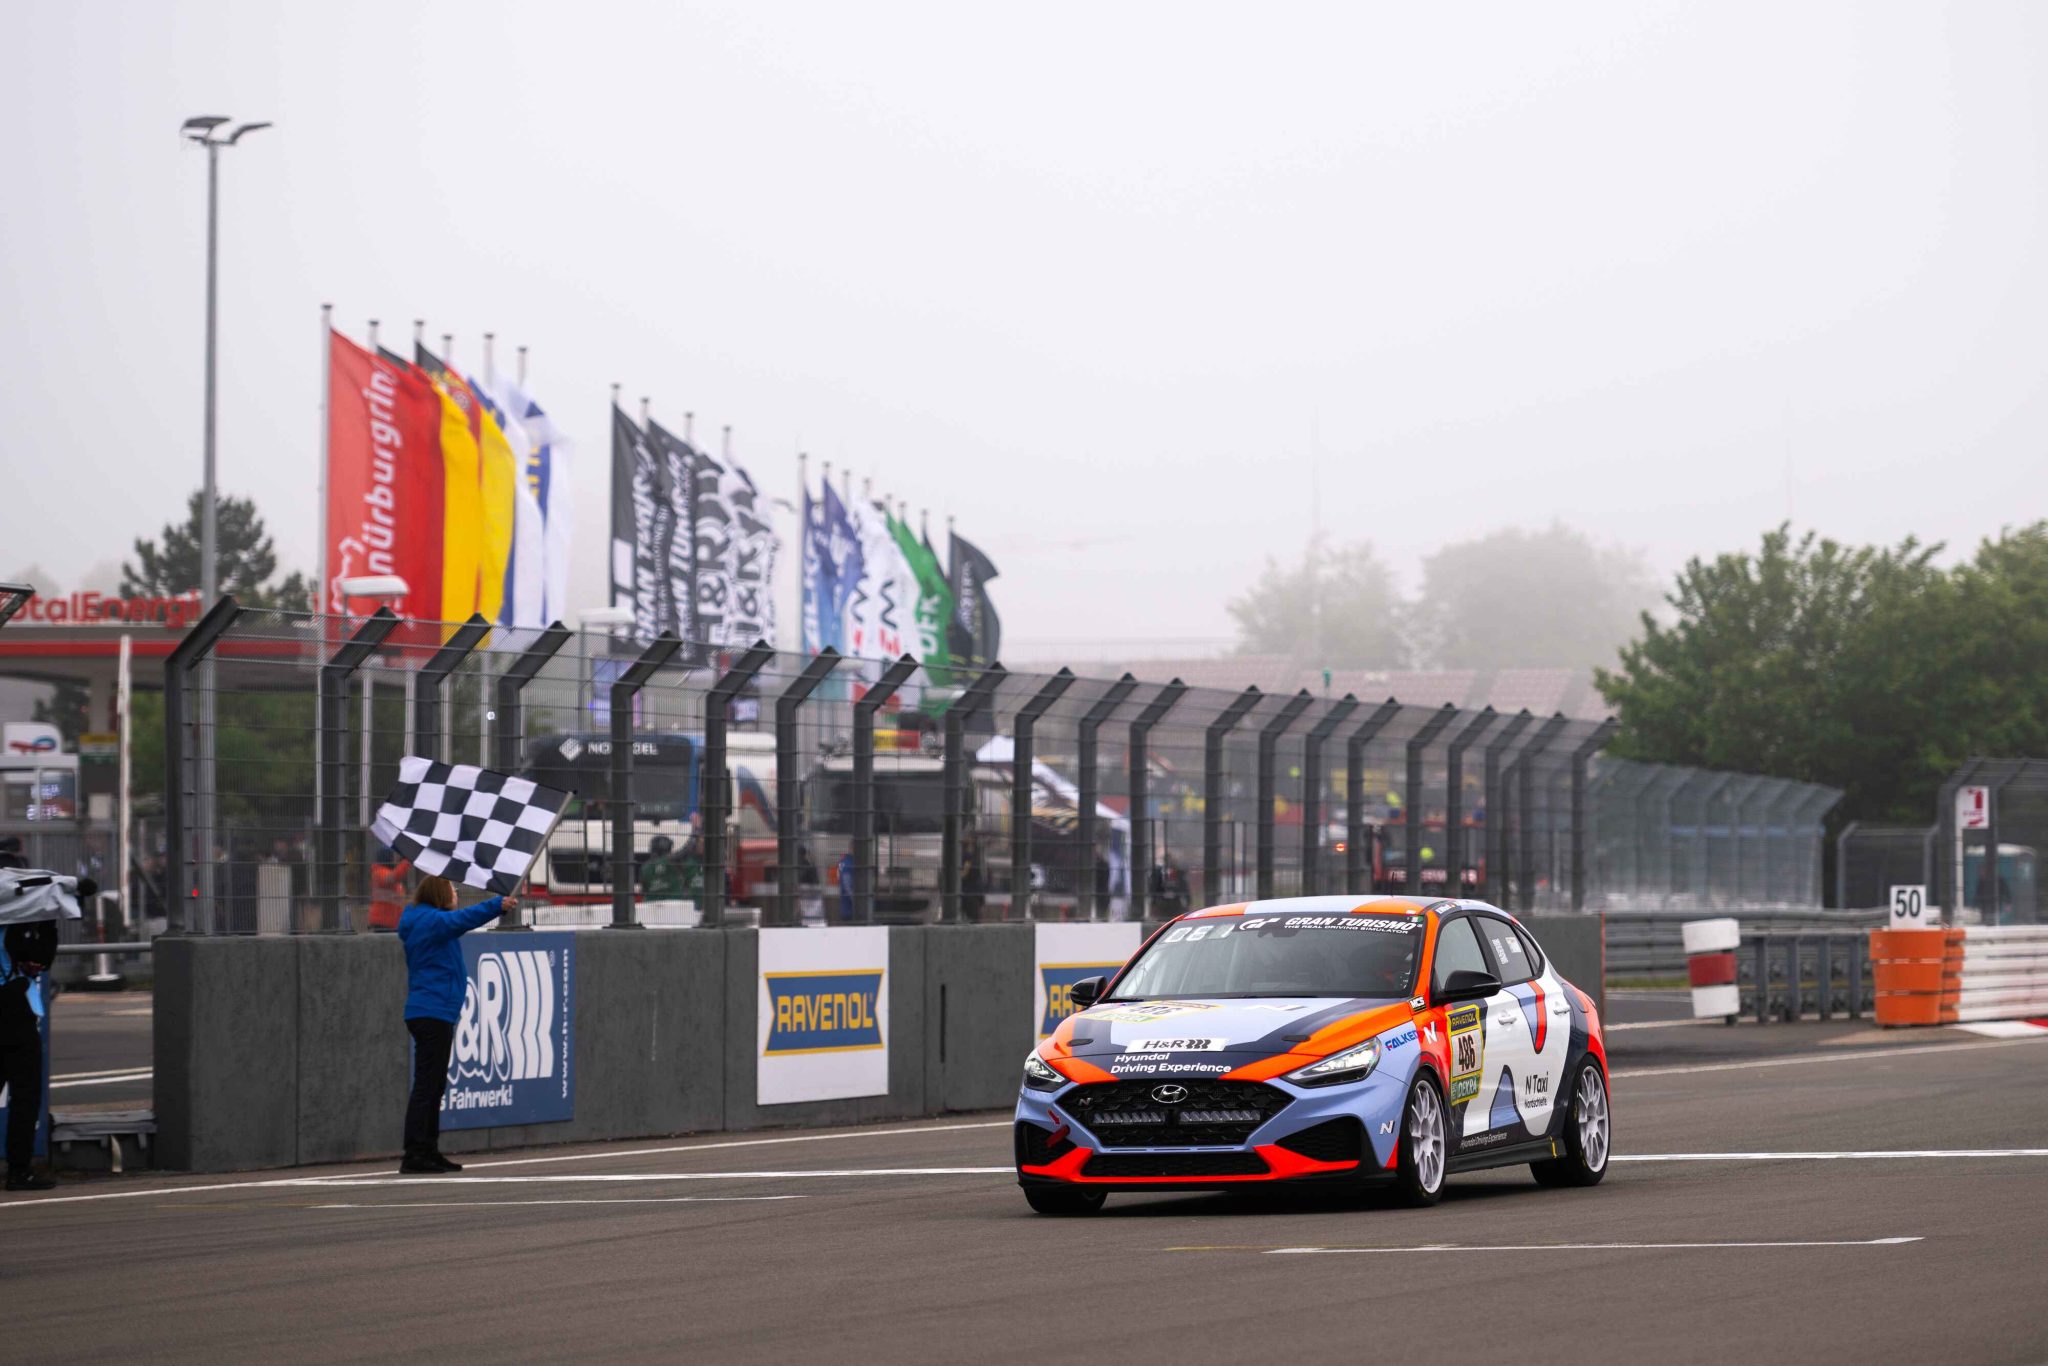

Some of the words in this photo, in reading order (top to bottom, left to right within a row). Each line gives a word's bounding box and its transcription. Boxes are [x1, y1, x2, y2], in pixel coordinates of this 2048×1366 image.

[1894, 889, 1921, 918] 50
[1284, 916, 1334, 927] GRAN
[1337, 916, 1417, 931] TURISMO
[1360, 926, 1409, 935] SIMULATOR
[777, 992, 874, 1033] RAVENOL
[1114, 1052, 1171, 1063] Hyundai
[1457, 1034, 1476, 1072] 486
[1110, 1063, 1157, 1074] Driving
[1158, 1062, 1232, 1074] Experience
[1525, 1074, 1533, 1095] N
[1533, 1070, 1549, 1094] Taxi
[448, 1084, 513, 1110] Fahrwerk!
